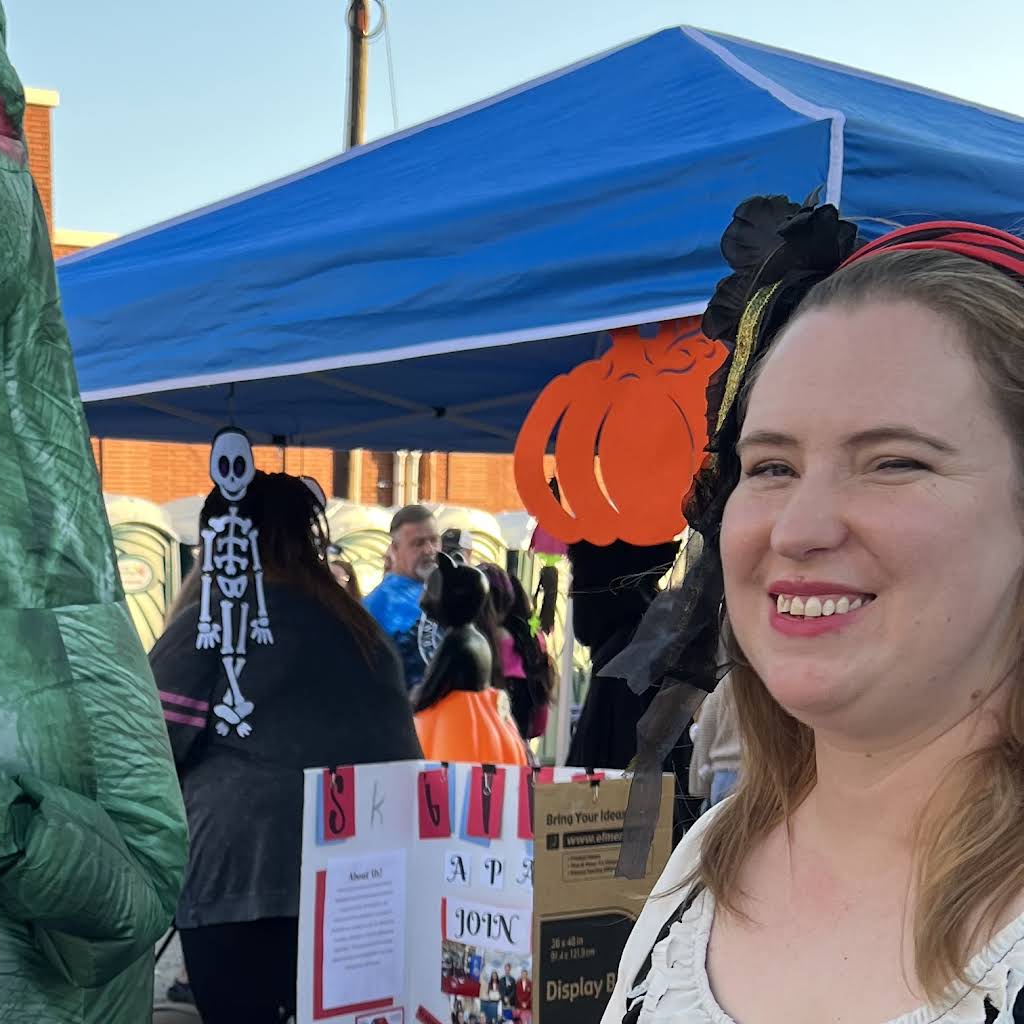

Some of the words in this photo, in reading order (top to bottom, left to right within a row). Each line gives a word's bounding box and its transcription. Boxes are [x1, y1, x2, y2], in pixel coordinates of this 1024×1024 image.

[546, 812, 574, 827] Bring
[575, 810, 600, 824] Your
[454, 908, 520, 946] JOIN
[546, 975, 603, 1003] Display
